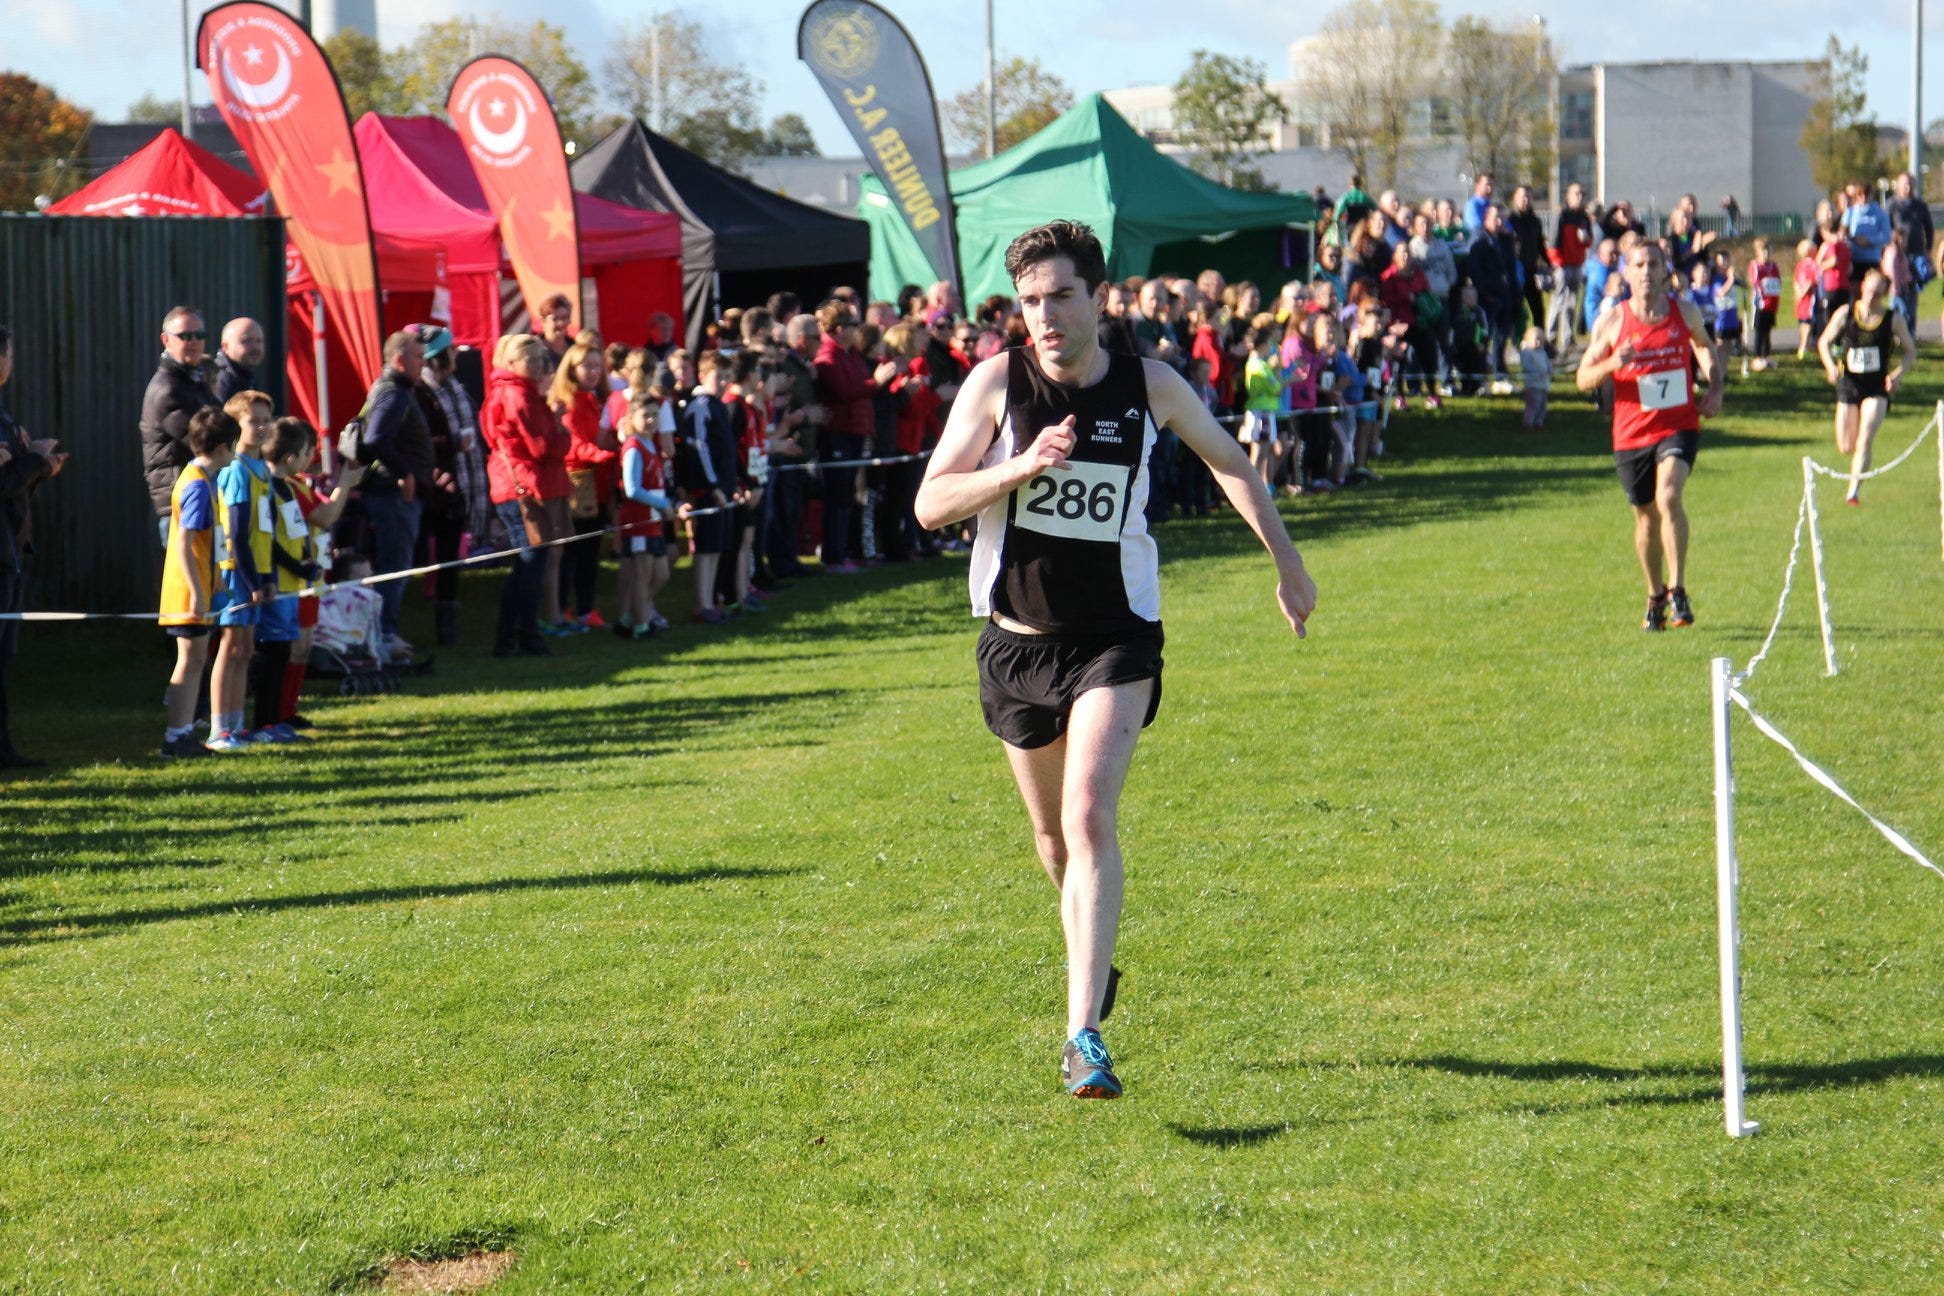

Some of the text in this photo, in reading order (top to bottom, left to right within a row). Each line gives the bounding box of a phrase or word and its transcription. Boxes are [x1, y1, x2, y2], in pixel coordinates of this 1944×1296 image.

[1656, 379, 1669, 399] 7
[1095, 420, 1119, 428] NORTH
[1091, 434, 1123, 443] RUNNERS
[1026, 475, 1117, 523] 286
